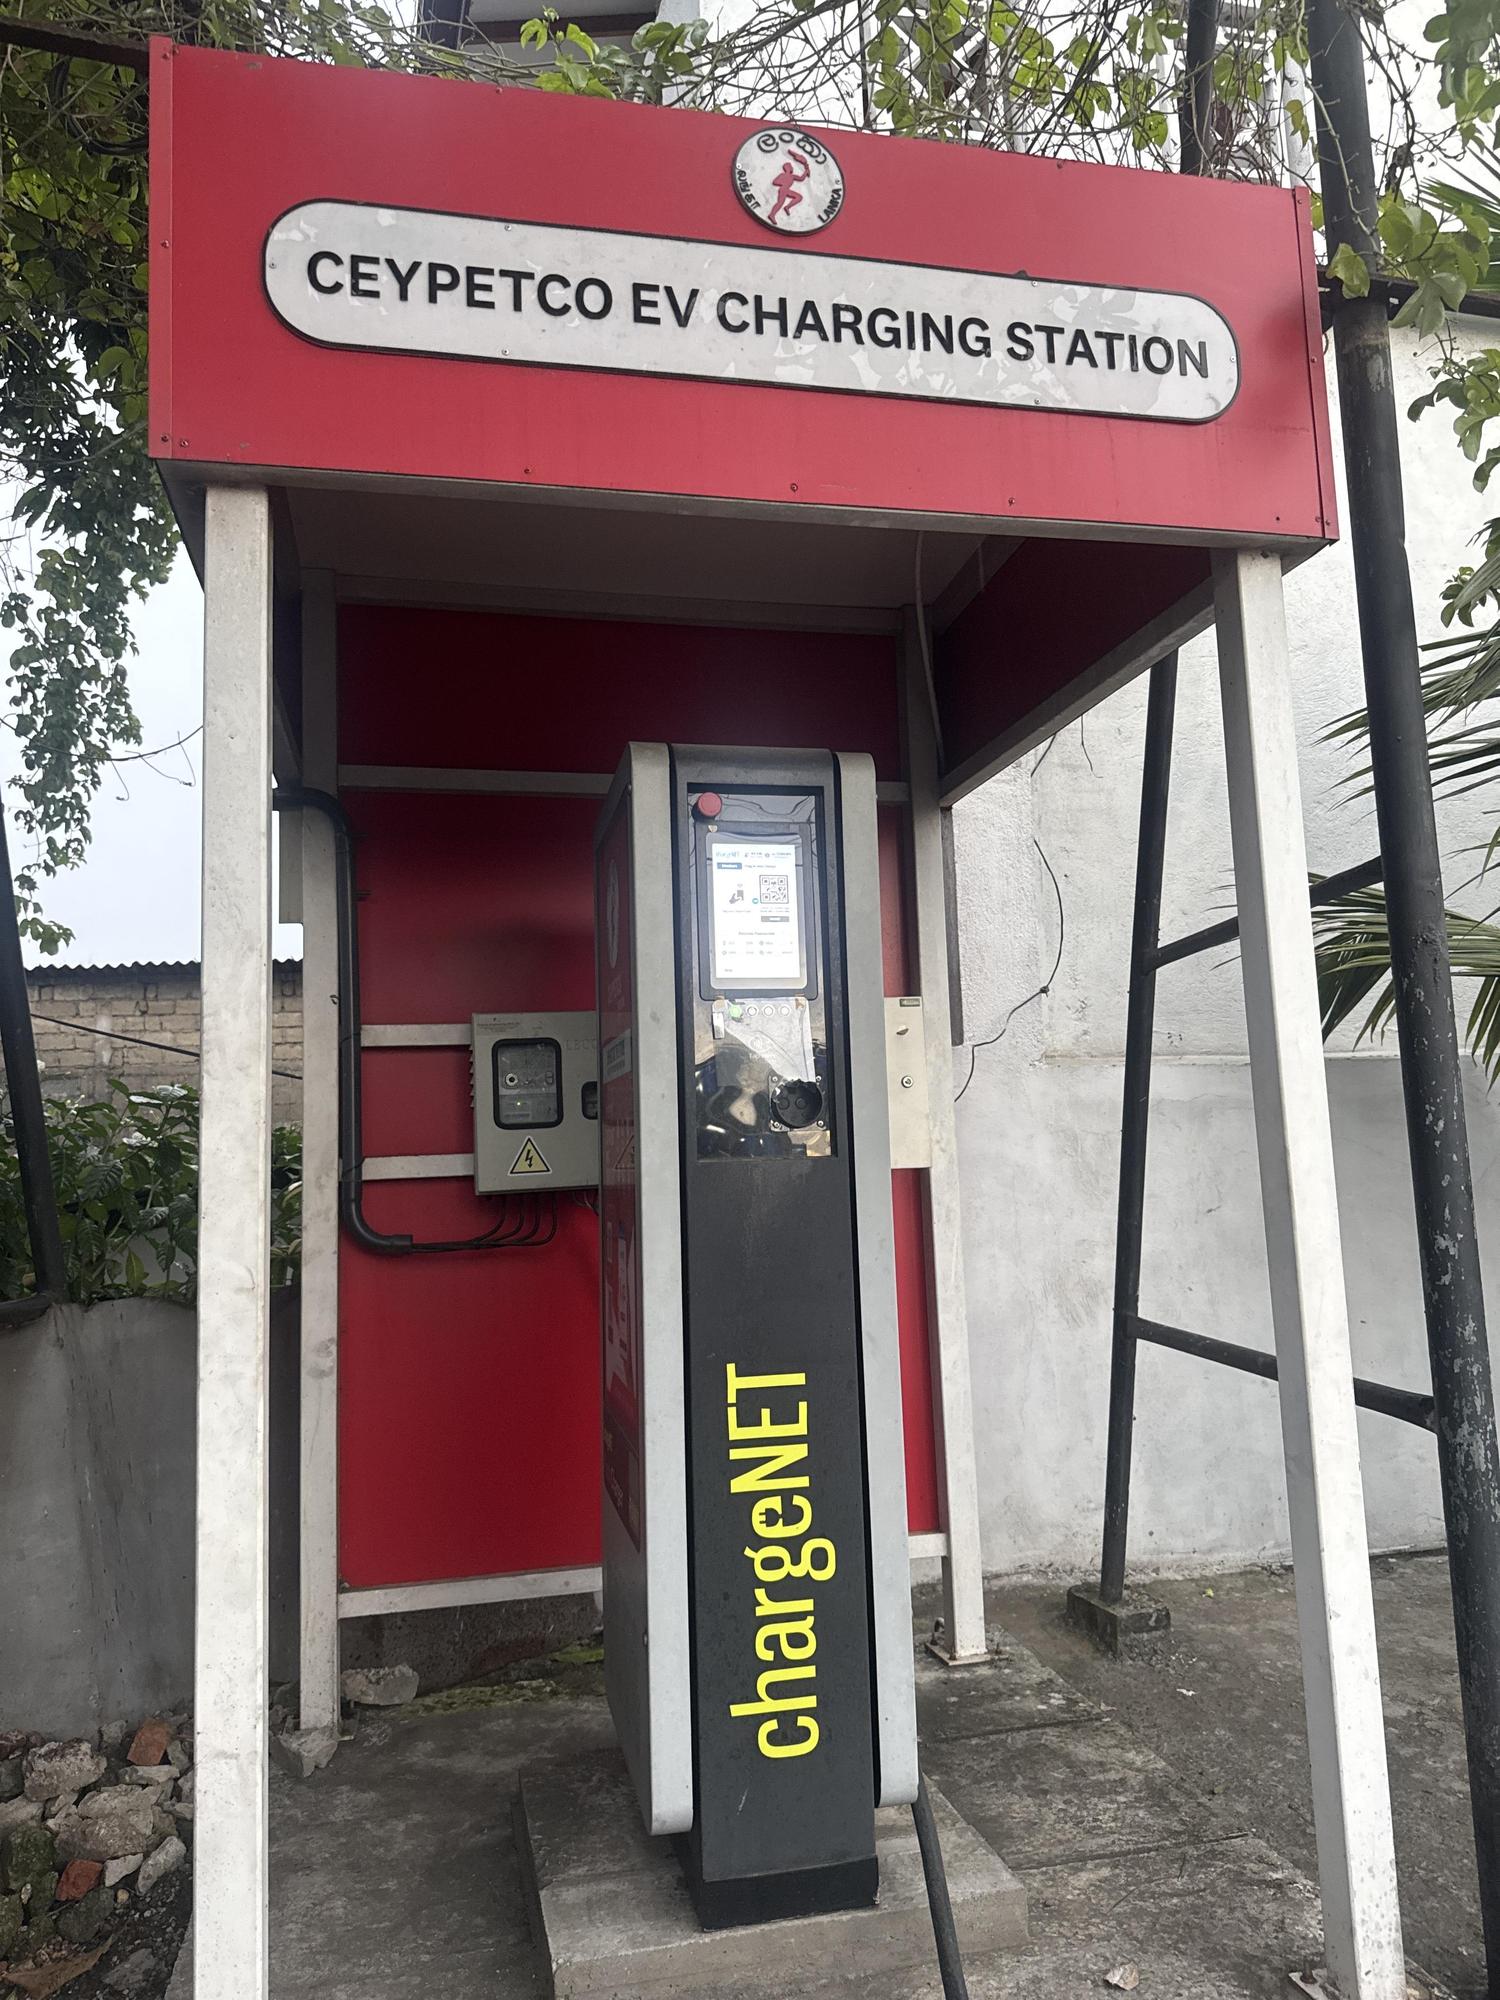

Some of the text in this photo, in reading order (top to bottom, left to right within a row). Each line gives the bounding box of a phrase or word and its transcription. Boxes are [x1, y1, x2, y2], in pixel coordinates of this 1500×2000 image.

[817, 188, 842, 223] LANKA
[307, 250, 1209, 380] CEYPETCO EV CHARGING STATION
[726, 1362, 837, 1759] chargeNET
